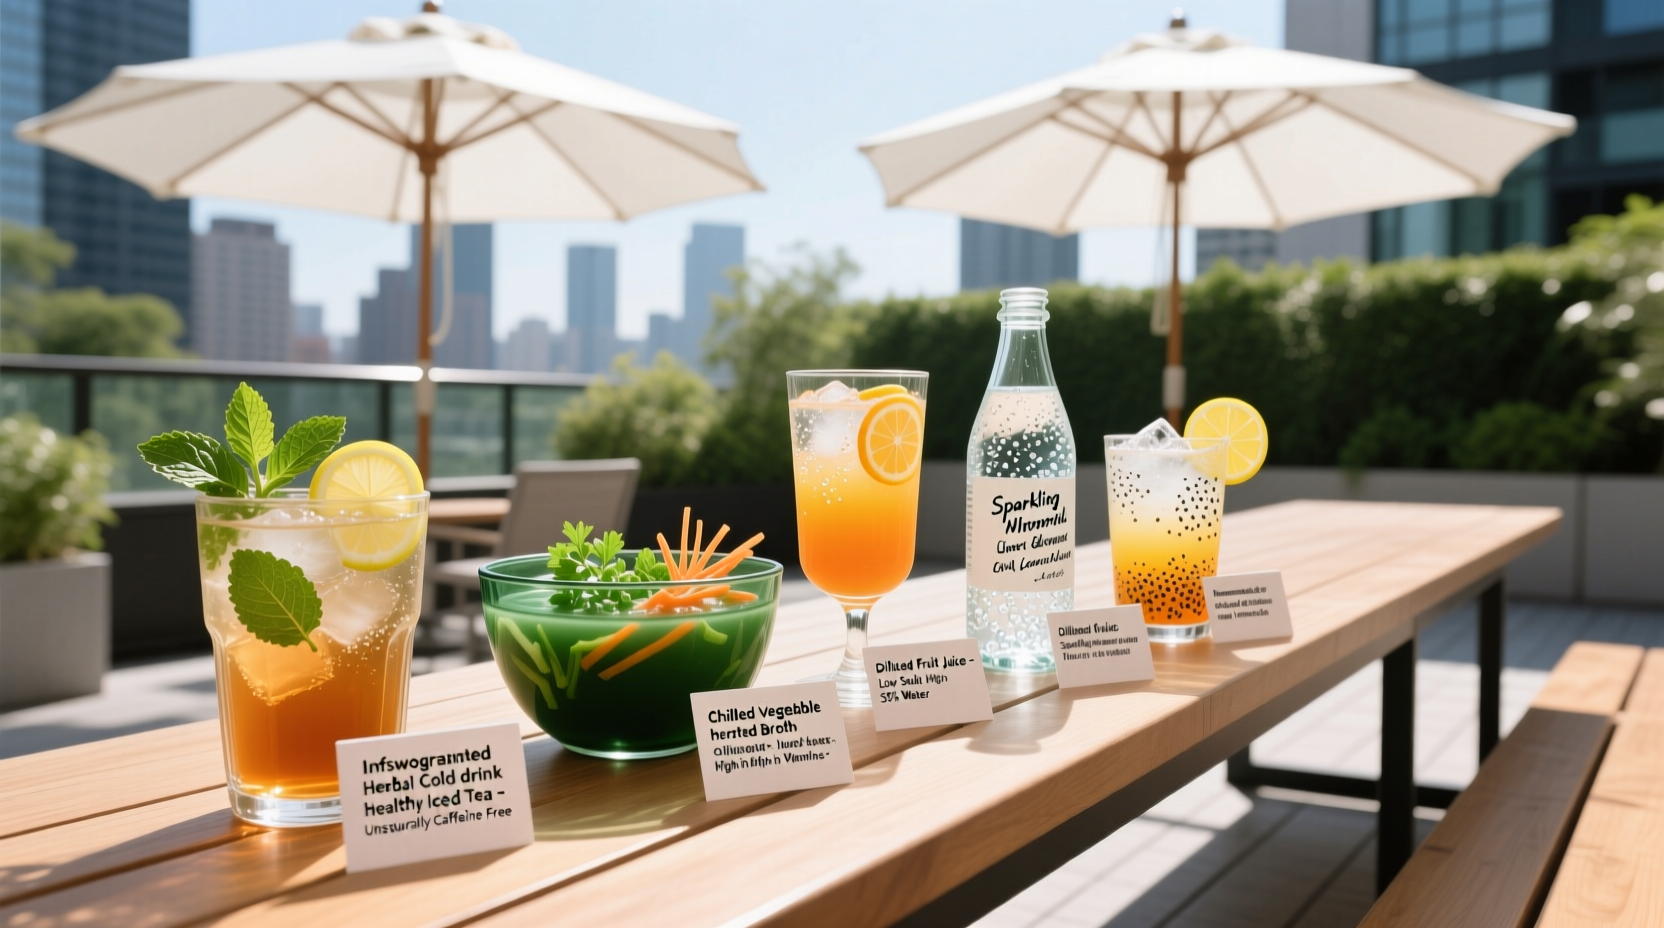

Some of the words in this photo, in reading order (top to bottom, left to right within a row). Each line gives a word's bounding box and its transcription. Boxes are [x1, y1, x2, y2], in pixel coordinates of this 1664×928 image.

[708, 706, 756, 723] Chilled
[760, 719, 798, 736] Broth
[363, 775, 414, 796] Herbal
[419, 769, 456, 789] Cold
[460, 764, 503, 784] drink
[364, 795, 423, 817] Healthy
[428, 789, 461, 809] Iced
[464, 788, 493, 802] Tea
[486, 806, 513, 820] Free
